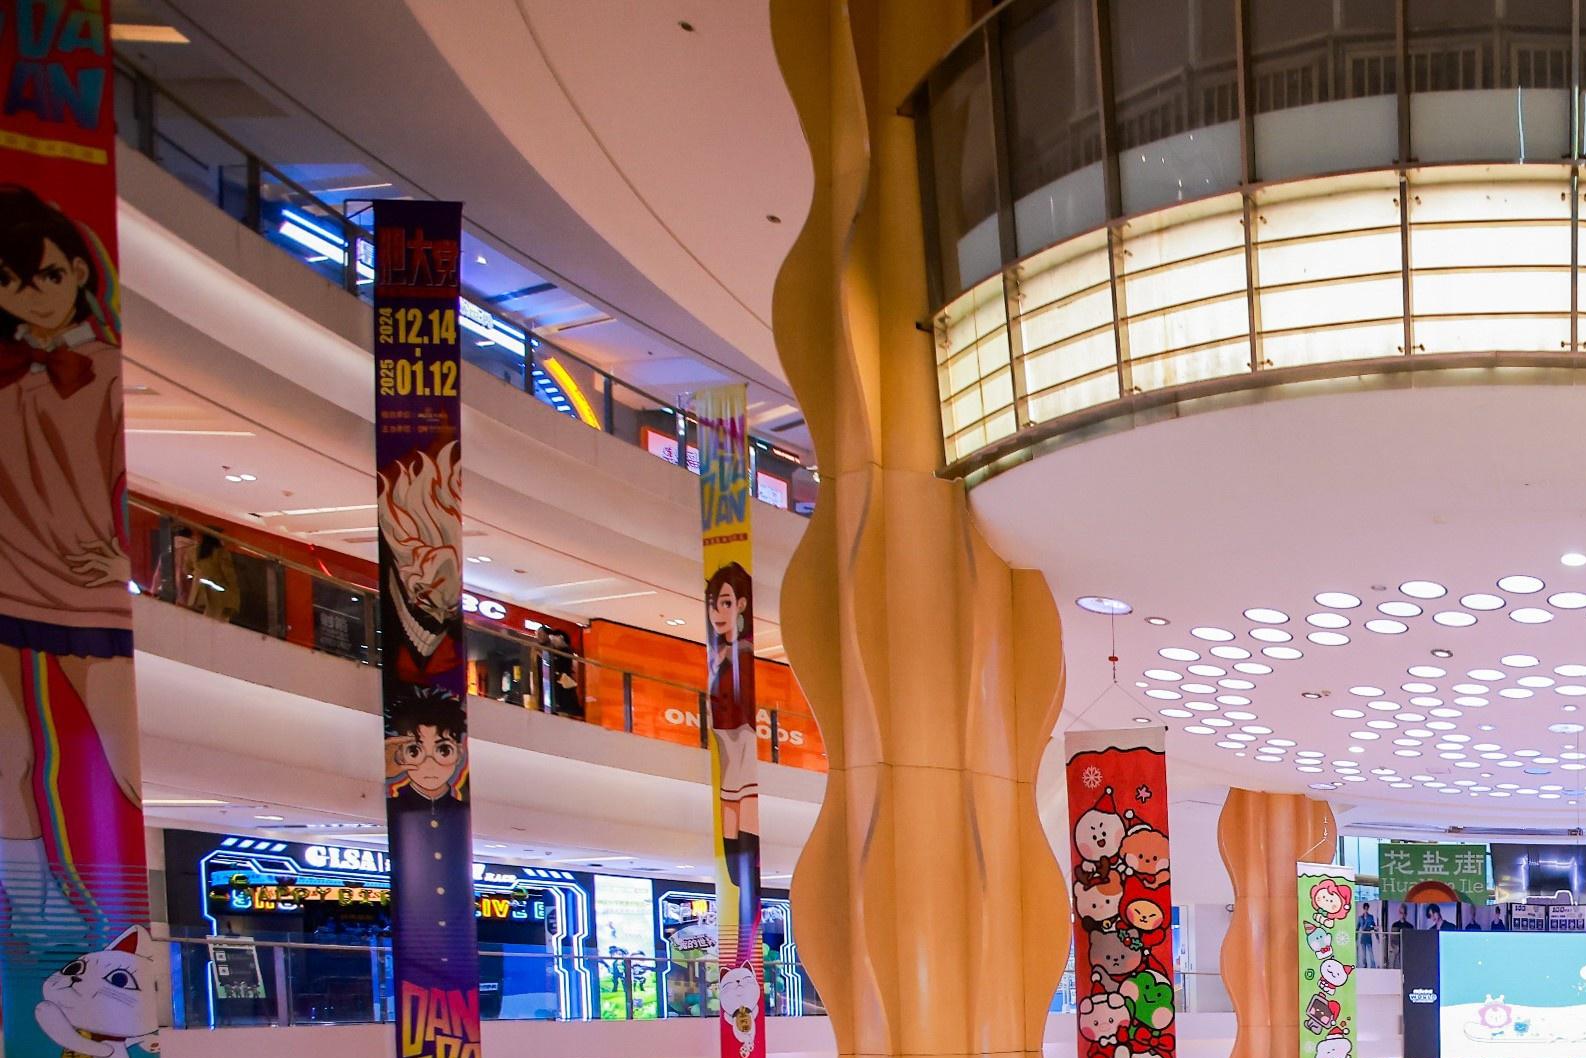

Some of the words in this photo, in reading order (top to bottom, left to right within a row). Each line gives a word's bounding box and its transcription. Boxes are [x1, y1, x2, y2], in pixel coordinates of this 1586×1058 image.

[379, 227, 458, 288] 胆大党
[379, 307, 394, 345] 2024
[395, 308, 457, 346] 12.14
[380, 359, 395, 397] 2025
[395, 360, 457, 397] 01.12
[1381, 851, 1484, 876] 花盐街
[402, 980, 480, 1058] DAN
